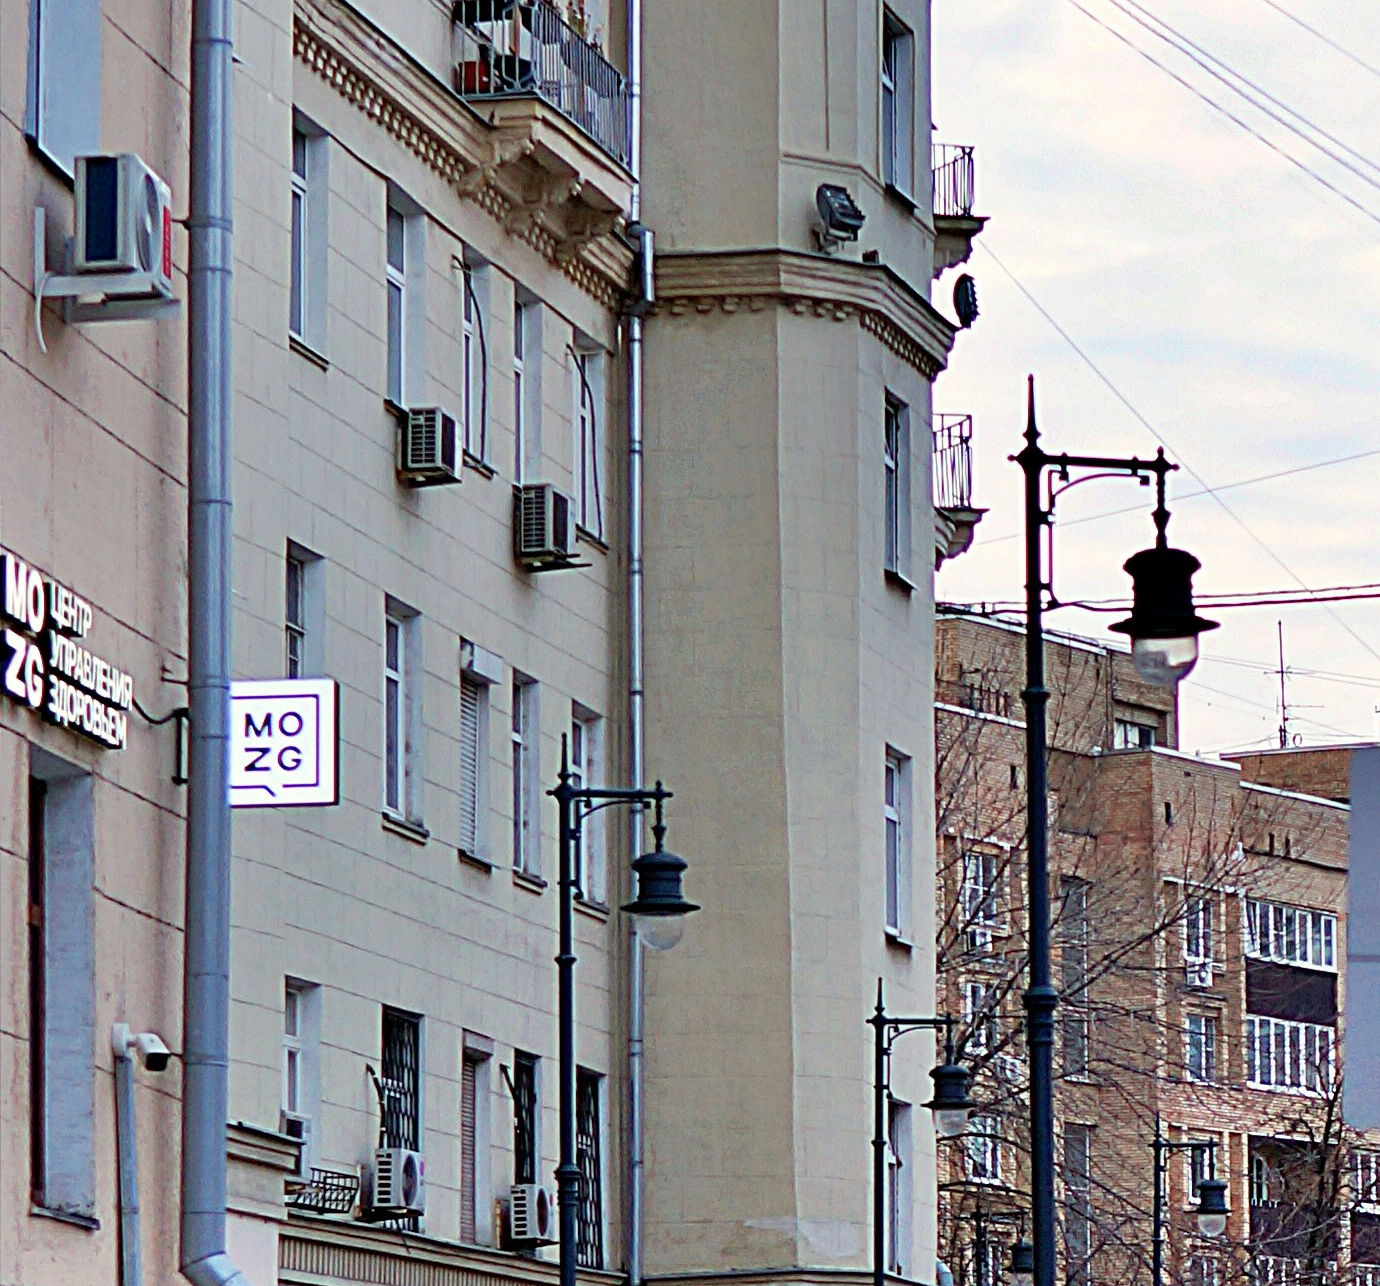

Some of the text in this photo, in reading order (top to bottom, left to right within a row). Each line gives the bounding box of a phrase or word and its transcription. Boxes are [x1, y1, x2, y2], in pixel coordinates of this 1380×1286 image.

[5, 554, 45, 633] MO
[50, 580, 93, 639] ЦЕНТР
[5, 628, 44, 708] ZG
[50, 629, 133, 711] УПРАВЛЕНИЯ
[48, 674, 127, 750] ЗДОРОВЬЕМ
[244, 711, 304, 738] MO
[244, 745, 303, 772] ZG
